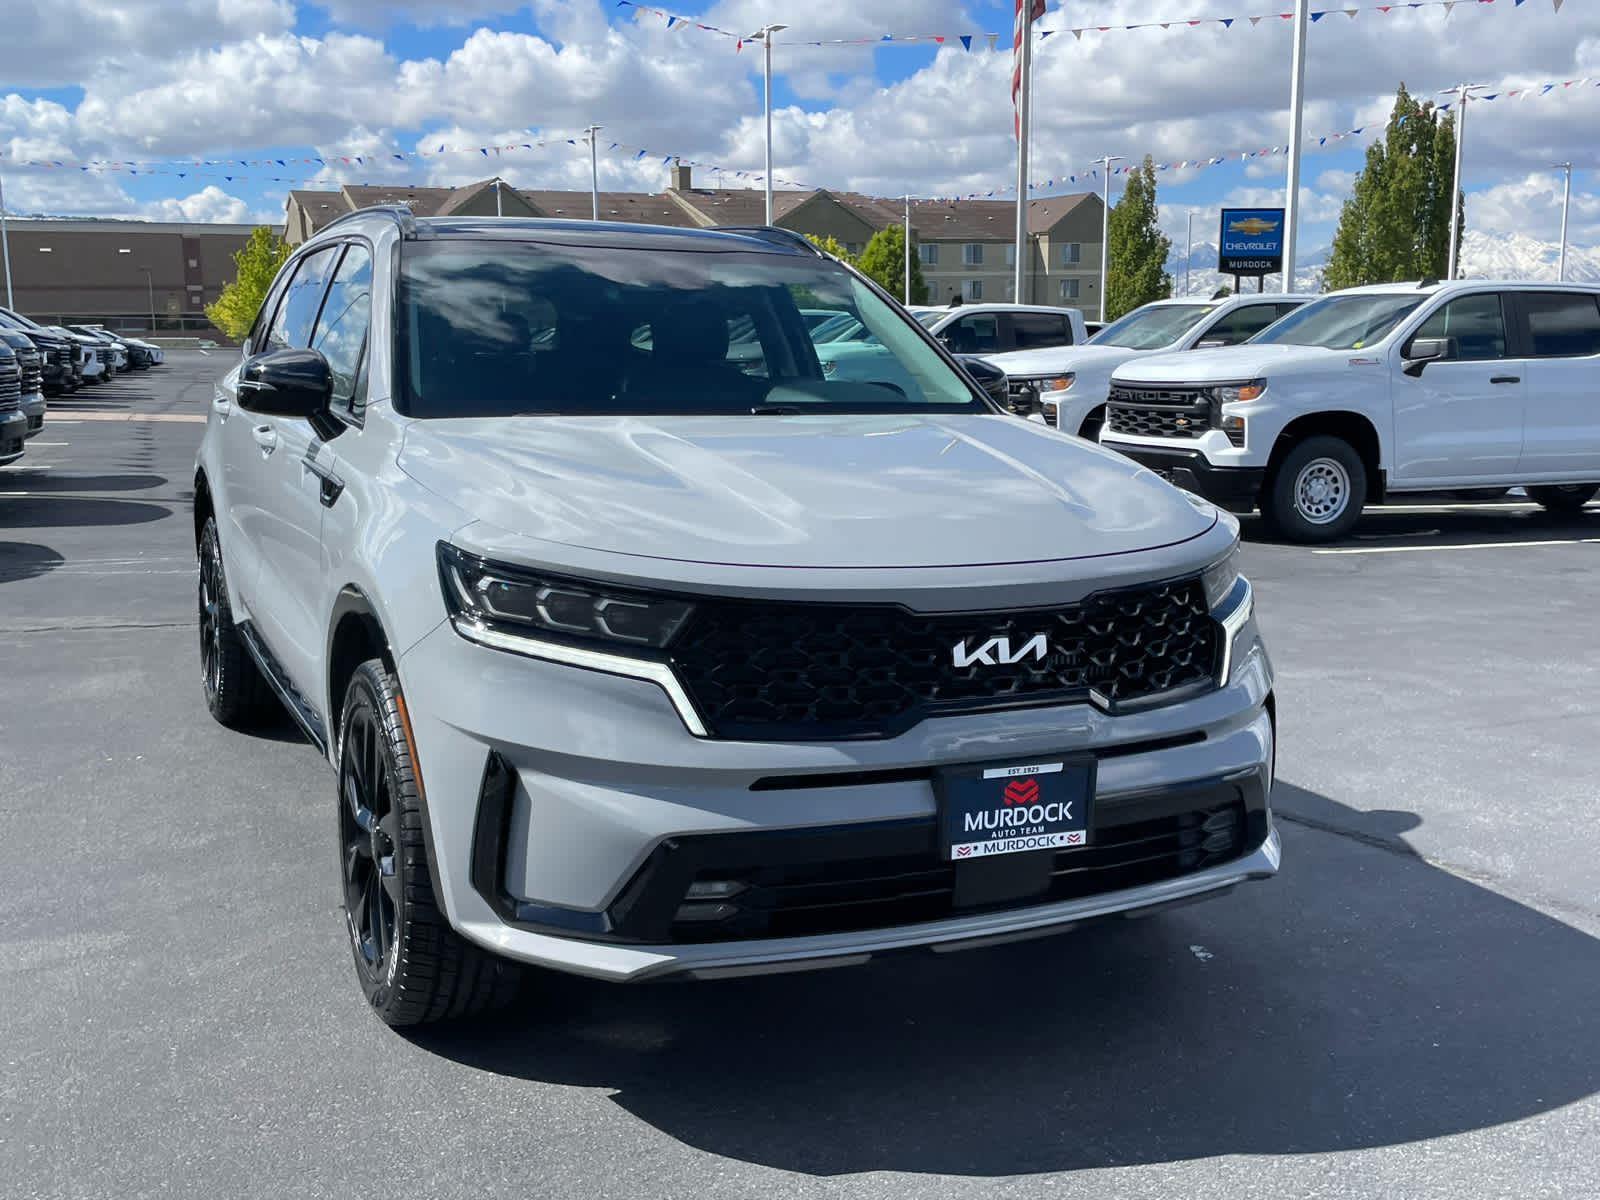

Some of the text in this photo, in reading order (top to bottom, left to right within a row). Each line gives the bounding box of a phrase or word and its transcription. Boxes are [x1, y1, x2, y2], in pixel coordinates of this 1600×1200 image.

[1225, 242, 1277, 250] CHEVROLET
[1229, 261, 1272, 269] MURDOCK
[953, 634, 1047, 668] KIA
[964, 801, 1073, 832] MURDOCK
[991, 826, 1045, 839] AUTO TEAM
[983, 835, 1056, 854] MURDOCK
